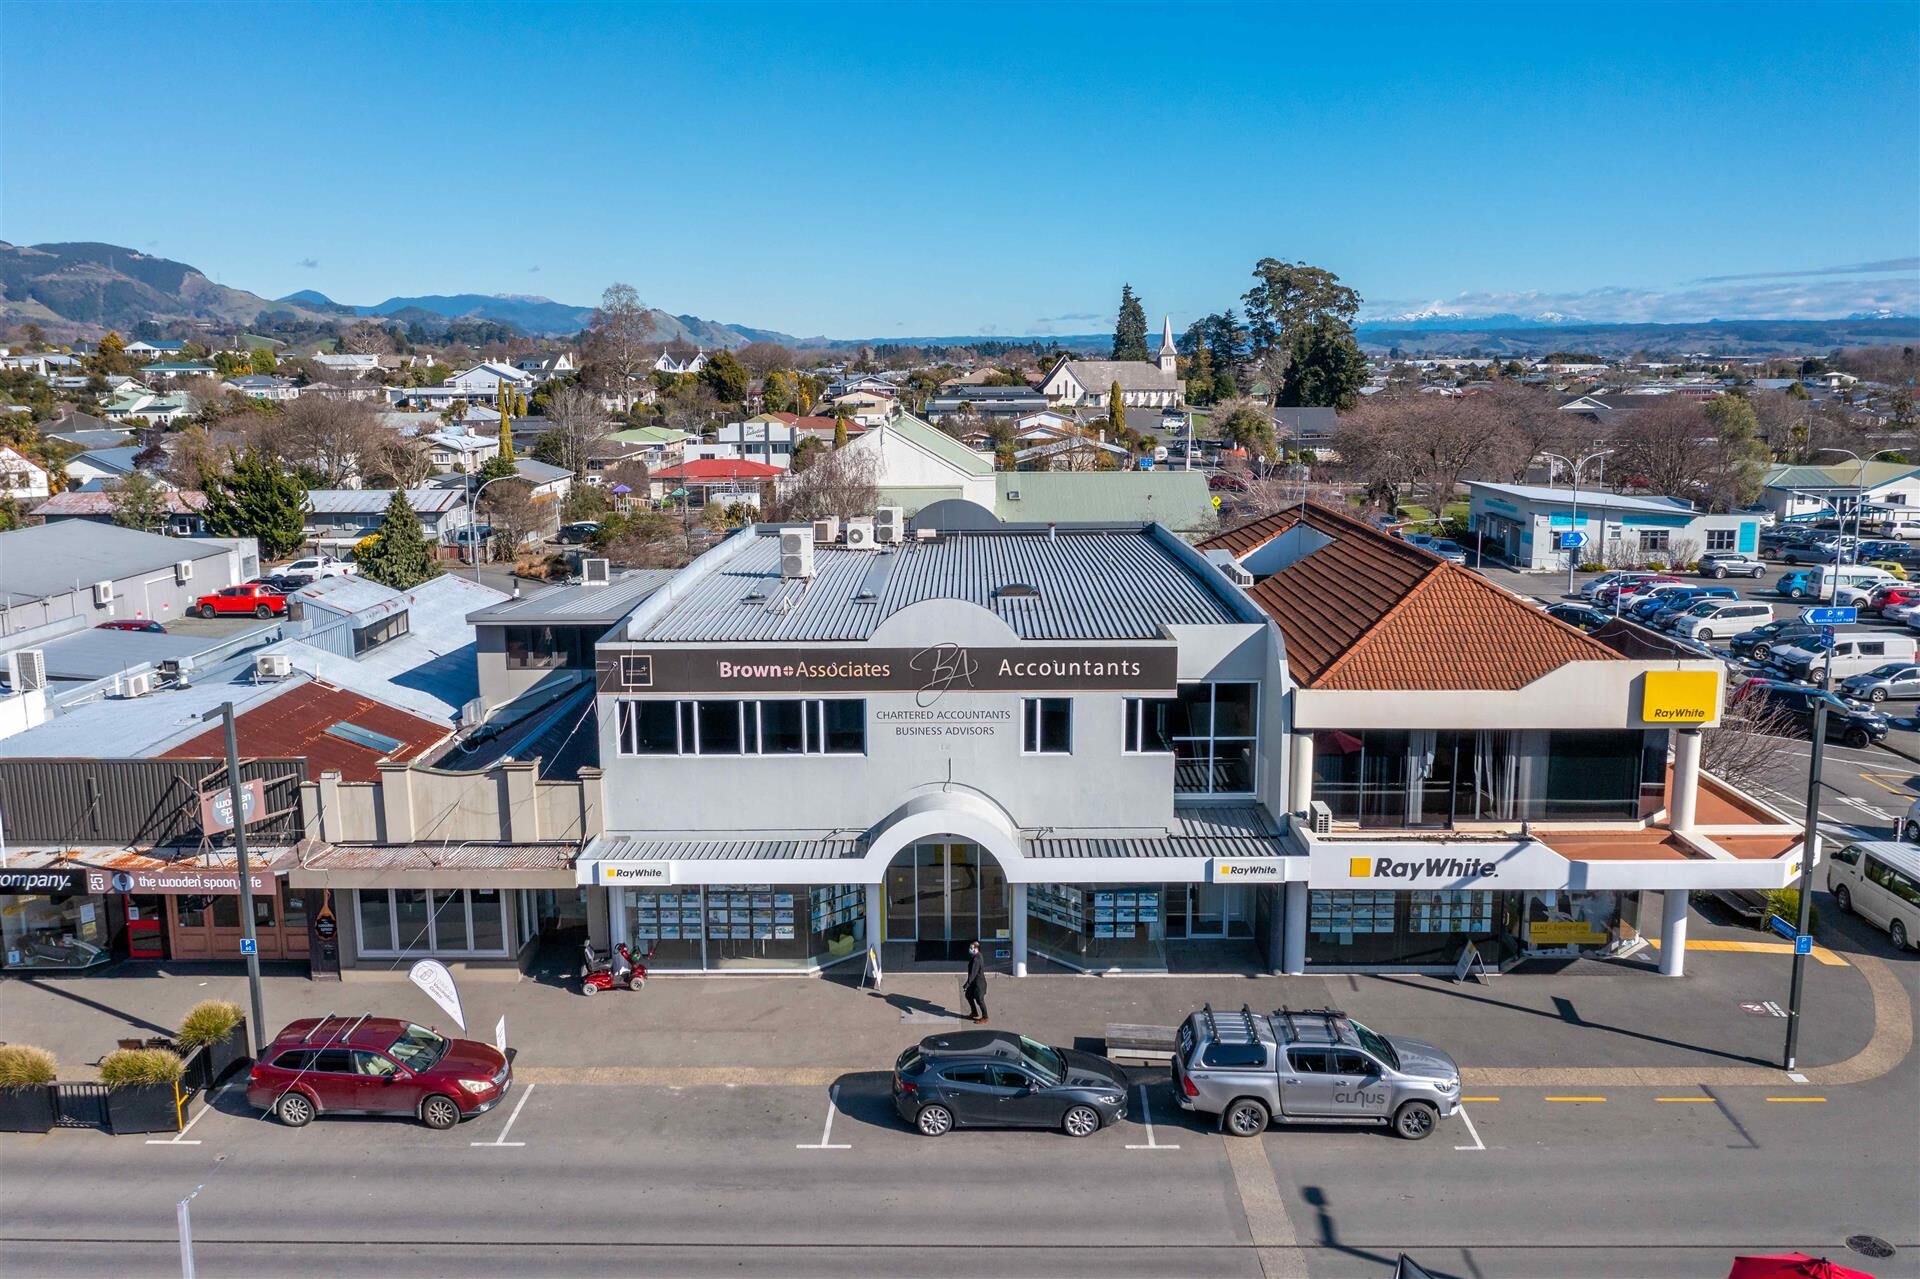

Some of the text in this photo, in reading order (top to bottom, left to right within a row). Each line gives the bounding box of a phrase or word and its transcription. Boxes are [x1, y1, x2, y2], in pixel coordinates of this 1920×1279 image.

[720, 660, 890, 678] Brown Associates
[998, 658, 1141, 676] Accountants
[876, 710, 1011, 720] CHARTERED ACCOUNTANTS
[895, 726, 995, 736] BUSINESS ADVISORS
[216, 793, 252, 809] woen
[220, 802, 248, 817] spn
[0, 874, 70, 890] ompany
[90, 873, 104, 890] 251
[138, 876, 262, 890] the wooden spoon fe
